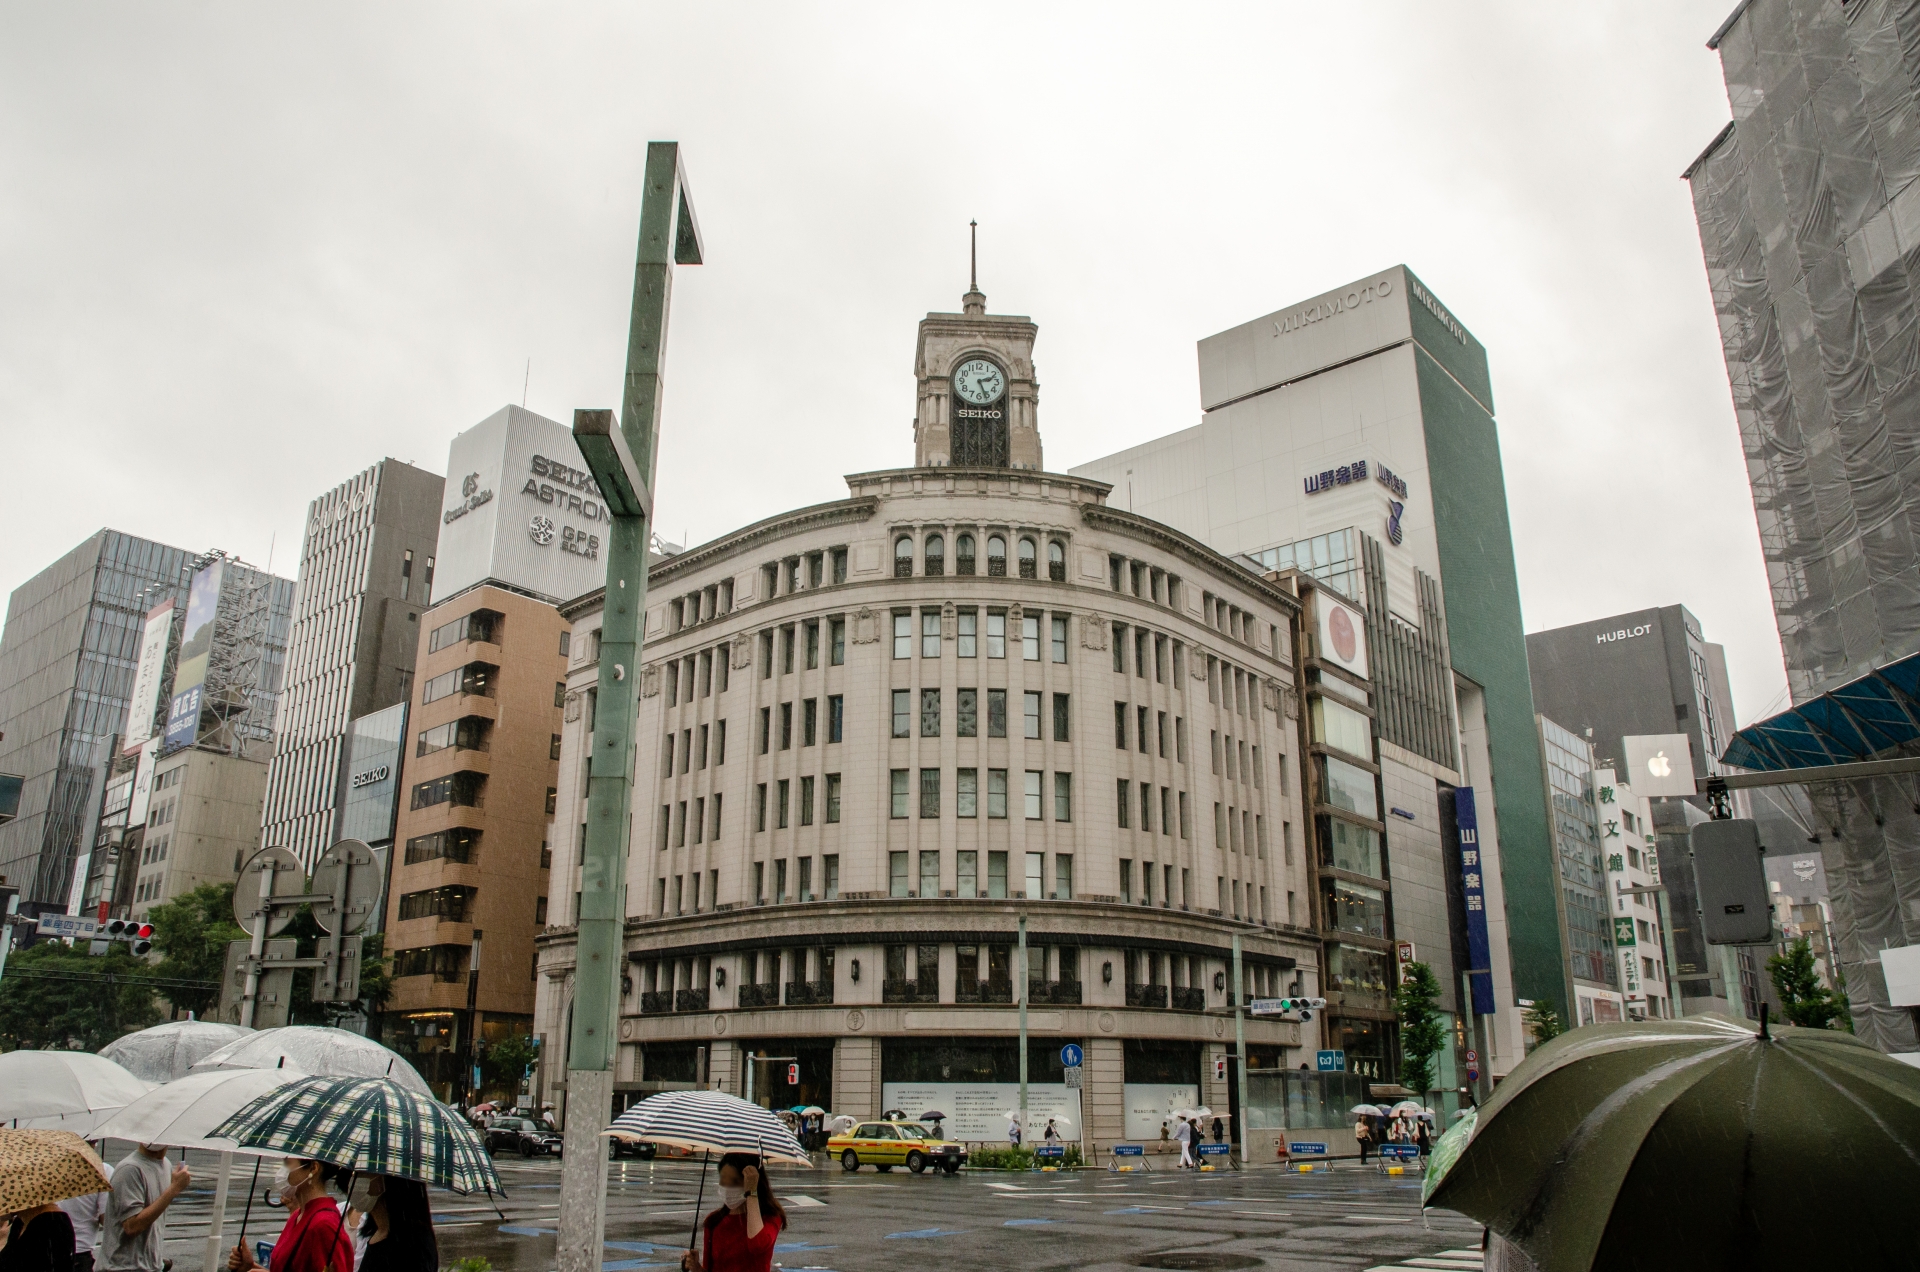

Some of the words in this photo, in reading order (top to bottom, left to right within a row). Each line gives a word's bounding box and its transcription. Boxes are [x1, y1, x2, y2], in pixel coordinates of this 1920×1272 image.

[1272, 281, 1393, 338] MIKIMOTO
[1412, 281, 1467, 346] MIKIMOTO
[958, 409, 1001, 419] SEIKO
[1303, 459, 1367, 494] 山野楽器
[1376, 460, 1408, 499] 山野楽器
[309, 484, 373, 537] GUCCI
[443, 499, 469, 525] Grand
[469, 488, 494, 510] Seiko
[521, 478, 612, 526] ASTRON
[560, 539, 599, 562] SOLAR
[562, 524, 600, 550] GPS
[1596, 624, 1652, 644] HUBLOT
[171, 688, 199, 720] 貸広告
[352, 765, 388, 788] SEIKO
[1599, 785, 1624, 872] 教文館
[1460, 828, 1482, 911] 山野楽器
[42, 918, 94, 932] 銀座四丁目
[1616, 921, 1633, 942] 本
